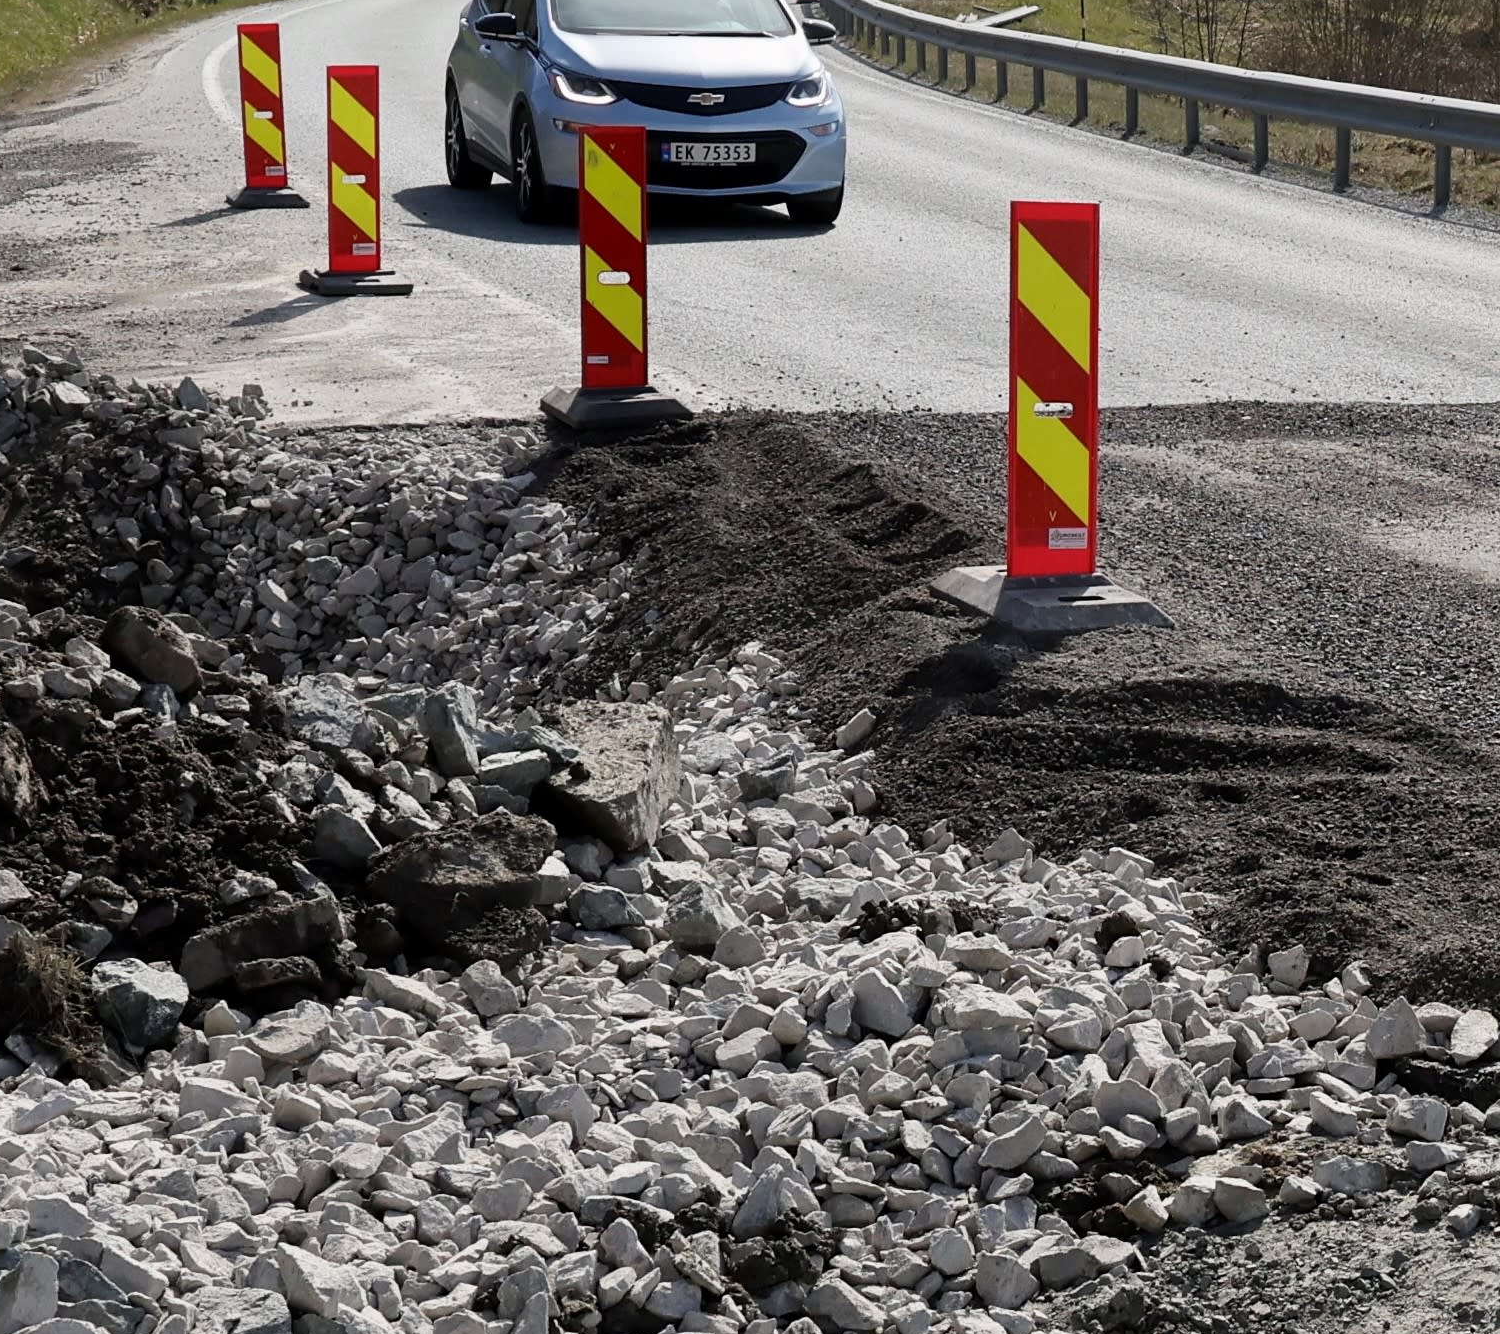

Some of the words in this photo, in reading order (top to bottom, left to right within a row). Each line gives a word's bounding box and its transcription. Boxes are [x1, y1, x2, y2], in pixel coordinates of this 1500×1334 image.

[675, 145, 694, 160] EK
[702, 145, 751, 160] 75353
[1049, 510, 1057, 522] V
